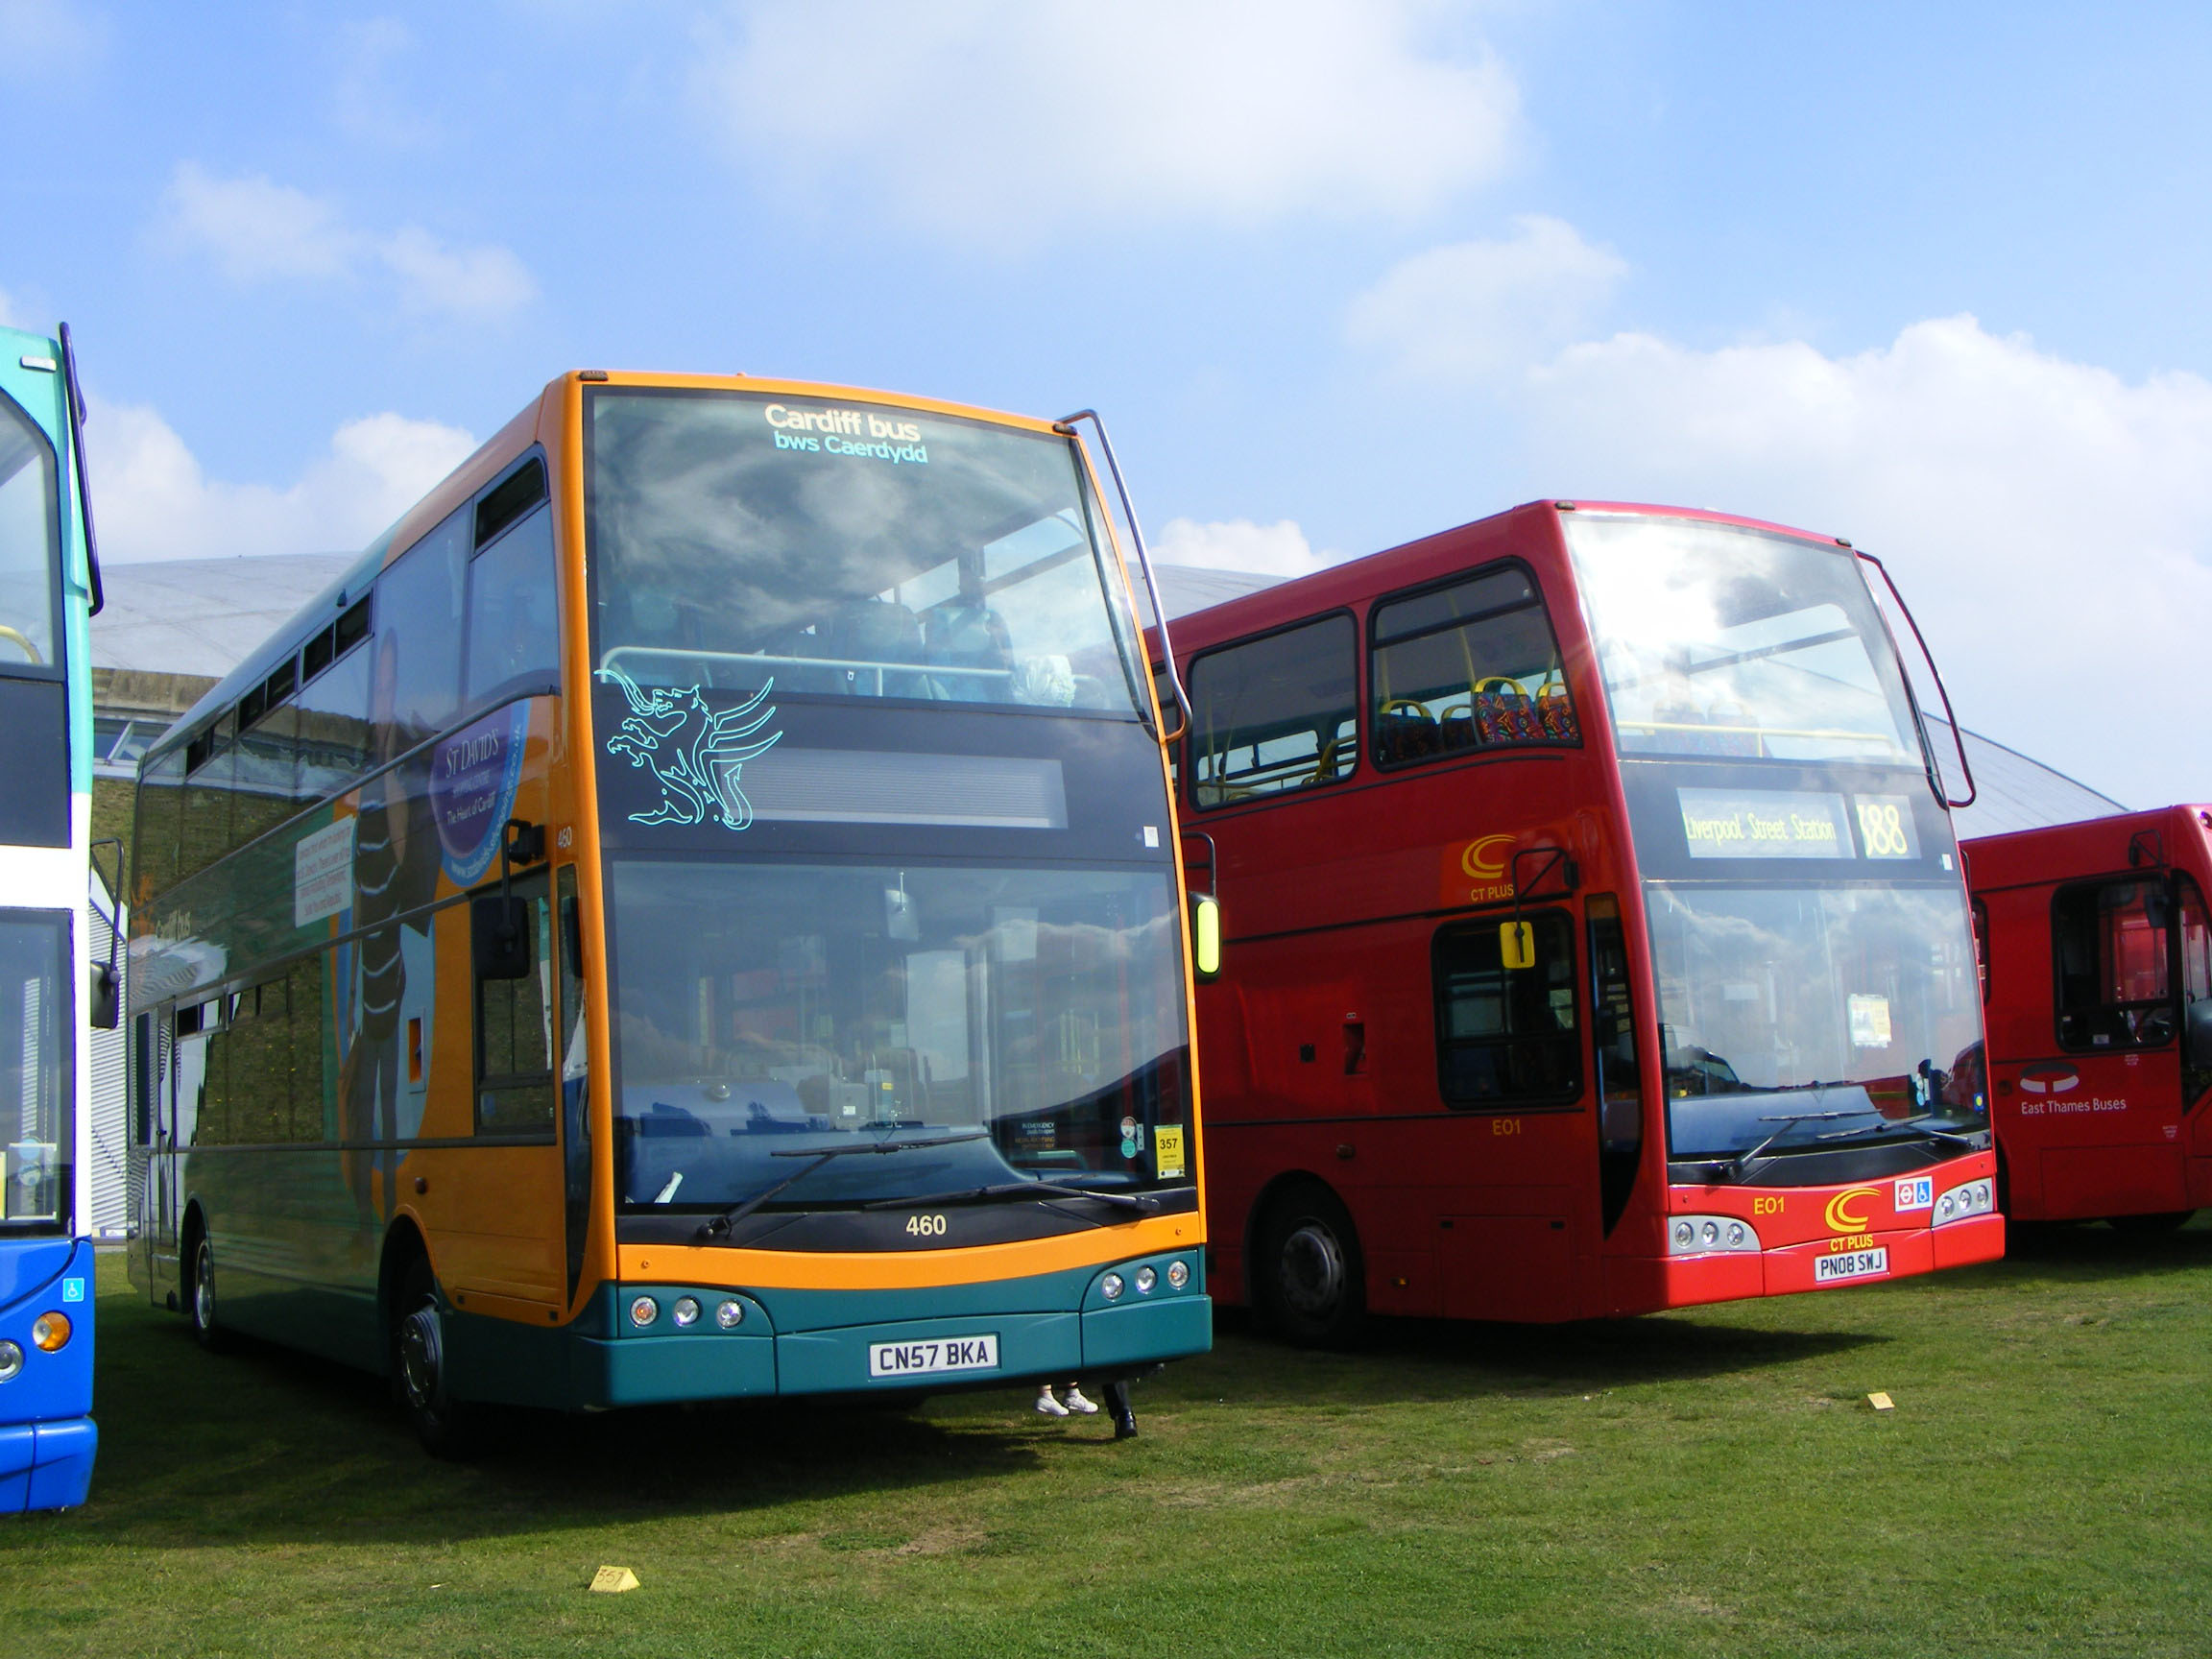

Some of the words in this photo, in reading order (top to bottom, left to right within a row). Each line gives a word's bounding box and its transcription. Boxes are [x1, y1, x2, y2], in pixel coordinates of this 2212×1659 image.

[765, 404, 861, 435] Cardiff
[868, 415, 921, 442] bus
[774, 430, 820, 452] bws
[824, 435, 928, 464] Caerdydd
[557, 826, 573, 849] 460
[1682, 812, 1745, 847] Liverpool
[1747, 812, 1789, 841] Street
[1791, 813, 1837, 841] Station
[1470, 888, 1485, 902] CT
[1487, 884, 1514, 900] PLUS
[2021, 1101, 2045, 1115] East
[2047, 1099, 2090, 1114] Thames
[2093, 1097, 2127, 1111] Buses
[1160, 1138, 1178, 1150] 357
[905, 1214, 947, 1237] 460
[1830, 1238, 1845, 1252] CT
[1847, 1235, 1873, 1249] PLUS
[1820, 1255, 1855, 1277] PN08
[1859, 1252, 1883, 1272] SWJ
[879, 1344, 939, 1371] CN57
[946, 1341, 989, 1365] BKA
